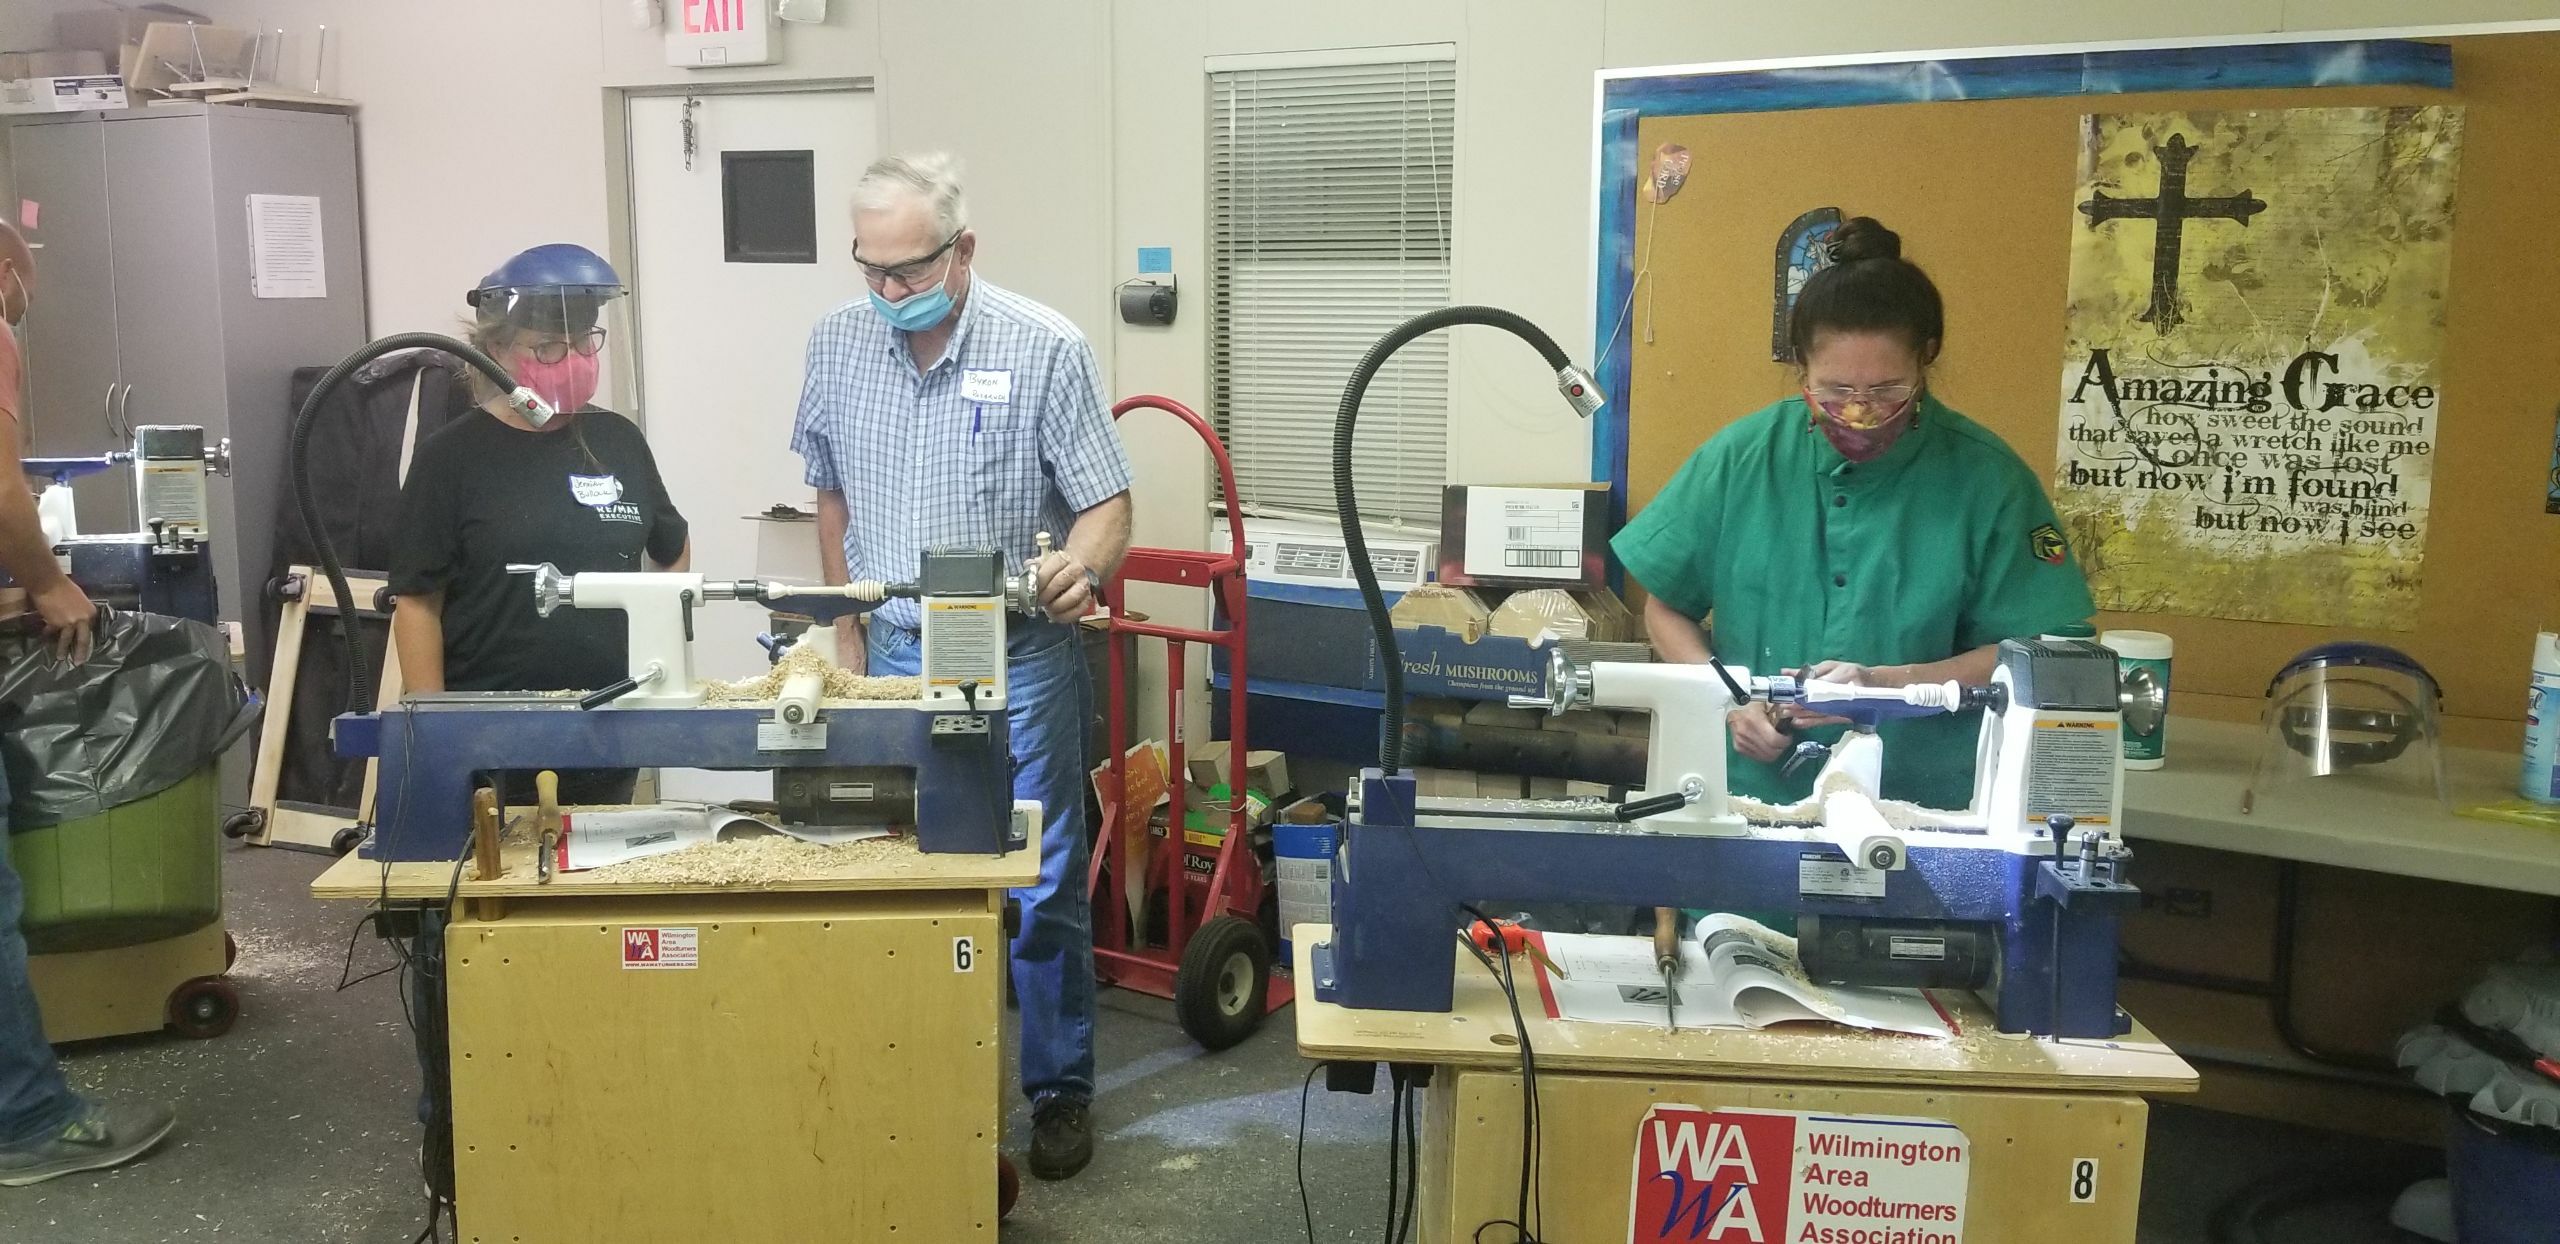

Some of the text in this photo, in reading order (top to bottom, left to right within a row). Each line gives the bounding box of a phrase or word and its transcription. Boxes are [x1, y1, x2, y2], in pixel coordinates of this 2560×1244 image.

[684, 0, 744, 34] EXIT
[2068, 348, 2435, 414] Amazing Grace
[2145, 405, 2425, 437] how sweet the sound
[2068, 422, 2118, 443] that
[2207, 432, 2223, 448] a
[2231, 430, 2323, 452] wretch
[2330, 429, 2380, 456] like
[2388, 439, 2431, 456] me
[2171, 448, 2248, 468] once
[2258, 451, 2321, 472] was
[2331, 451, 2393, 476] lost
[2069, 459, 2127, 488] but
[2136, 469, 2213, 492] now
[2288, 469, 2400, 506] found
[2195, 505, 2250, 531] but
[2258, 515, 2330, 535] now
[2360, 520, 2417, 540] see
[2301, 499, 2408, 518] was blind
[1445, 663, 1538, 684] MUSHROOMS
[956, 939, 971, 970] 6
[1808, 1132, 1961, 1166] Wilmington
[1803, 1162, 1869, 1187] Area
[2074, 1160, 2094, 1200] 8
[1803, 1192, 1957, 1222] Woodturners
[1799, 1221, 1957, 1244] Association
